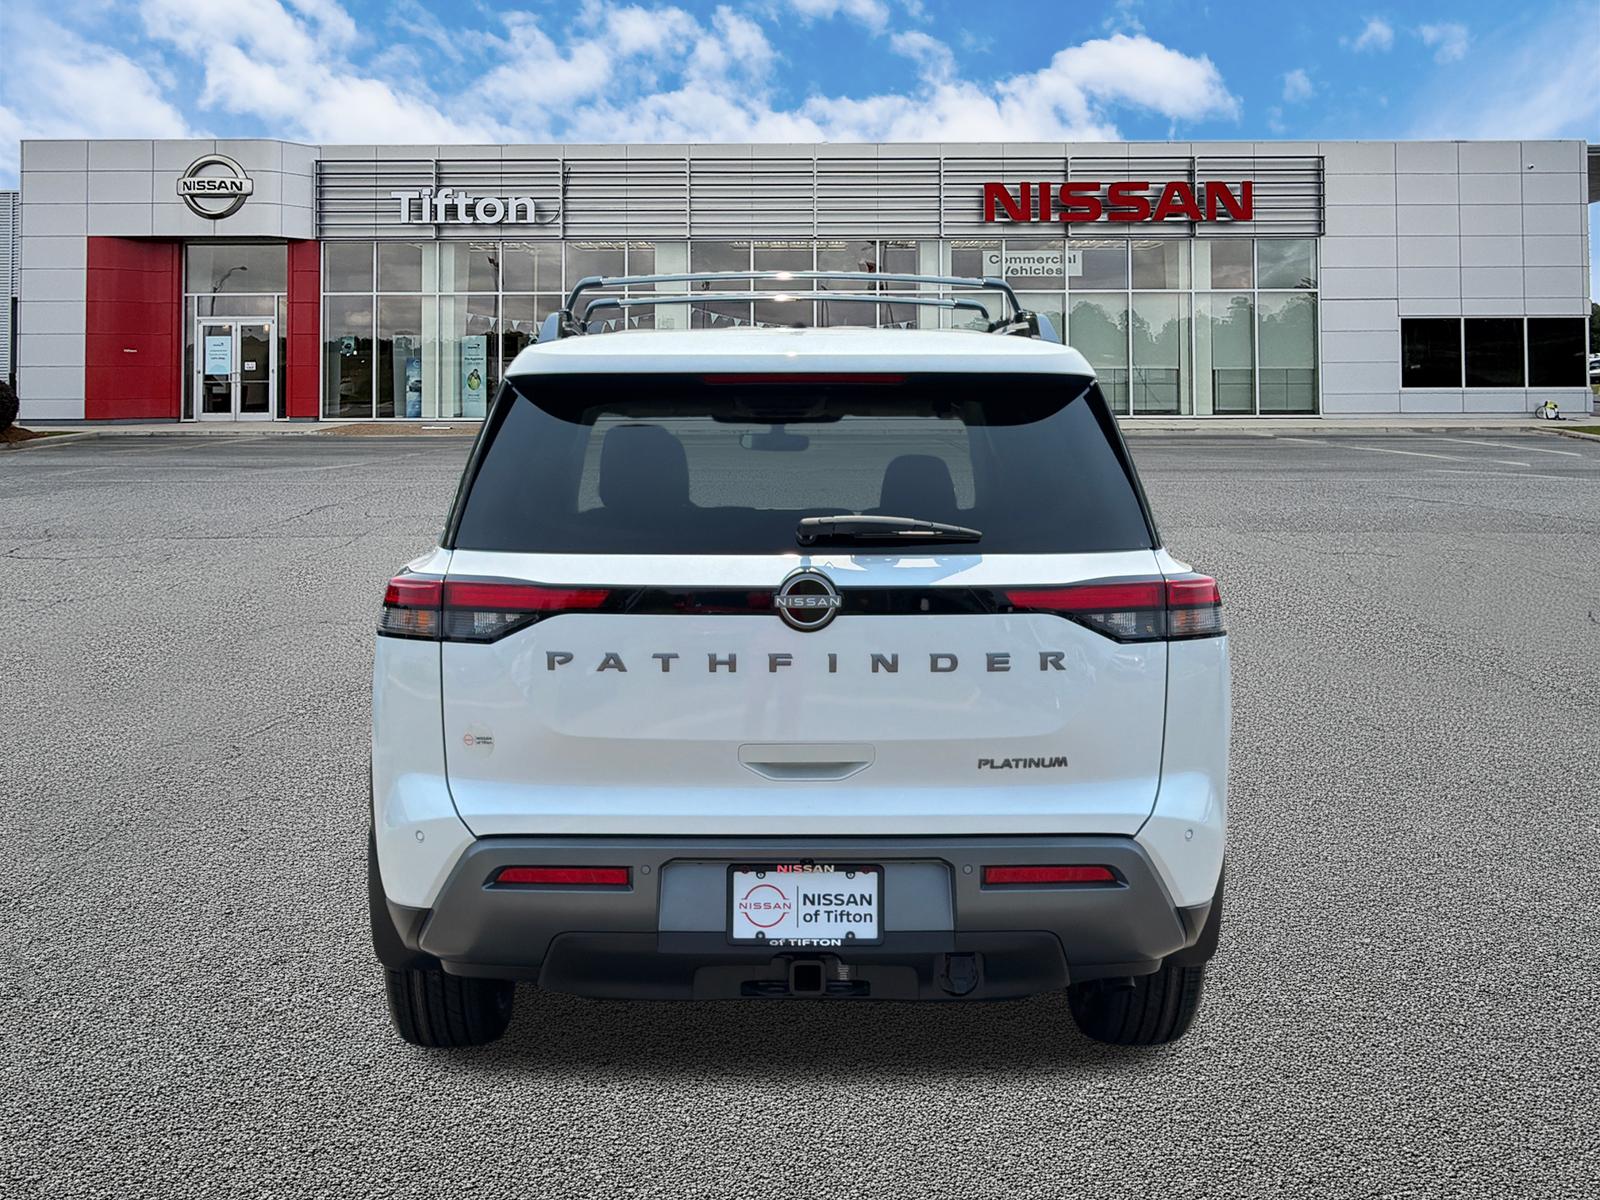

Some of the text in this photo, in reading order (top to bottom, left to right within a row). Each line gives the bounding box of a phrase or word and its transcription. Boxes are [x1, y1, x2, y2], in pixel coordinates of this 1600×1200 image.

[182, 180, 243, 192] NISSAN
[390, 188, 536, 224] Tifton
[983, 181, 1253, 222] NISSAN
[776, 597, 841, 607] NISSAN
[546, 650, 1067, 673] PATHFINDER
[977, 756, 1068, 769] PLATINUM
[777, 865, 835, 873] NISSAN
[739, 902, 792, 910] NISSAN
[802, 893, 873, 906] NISSAN
[802, 909, 873, 923] of Tifton
